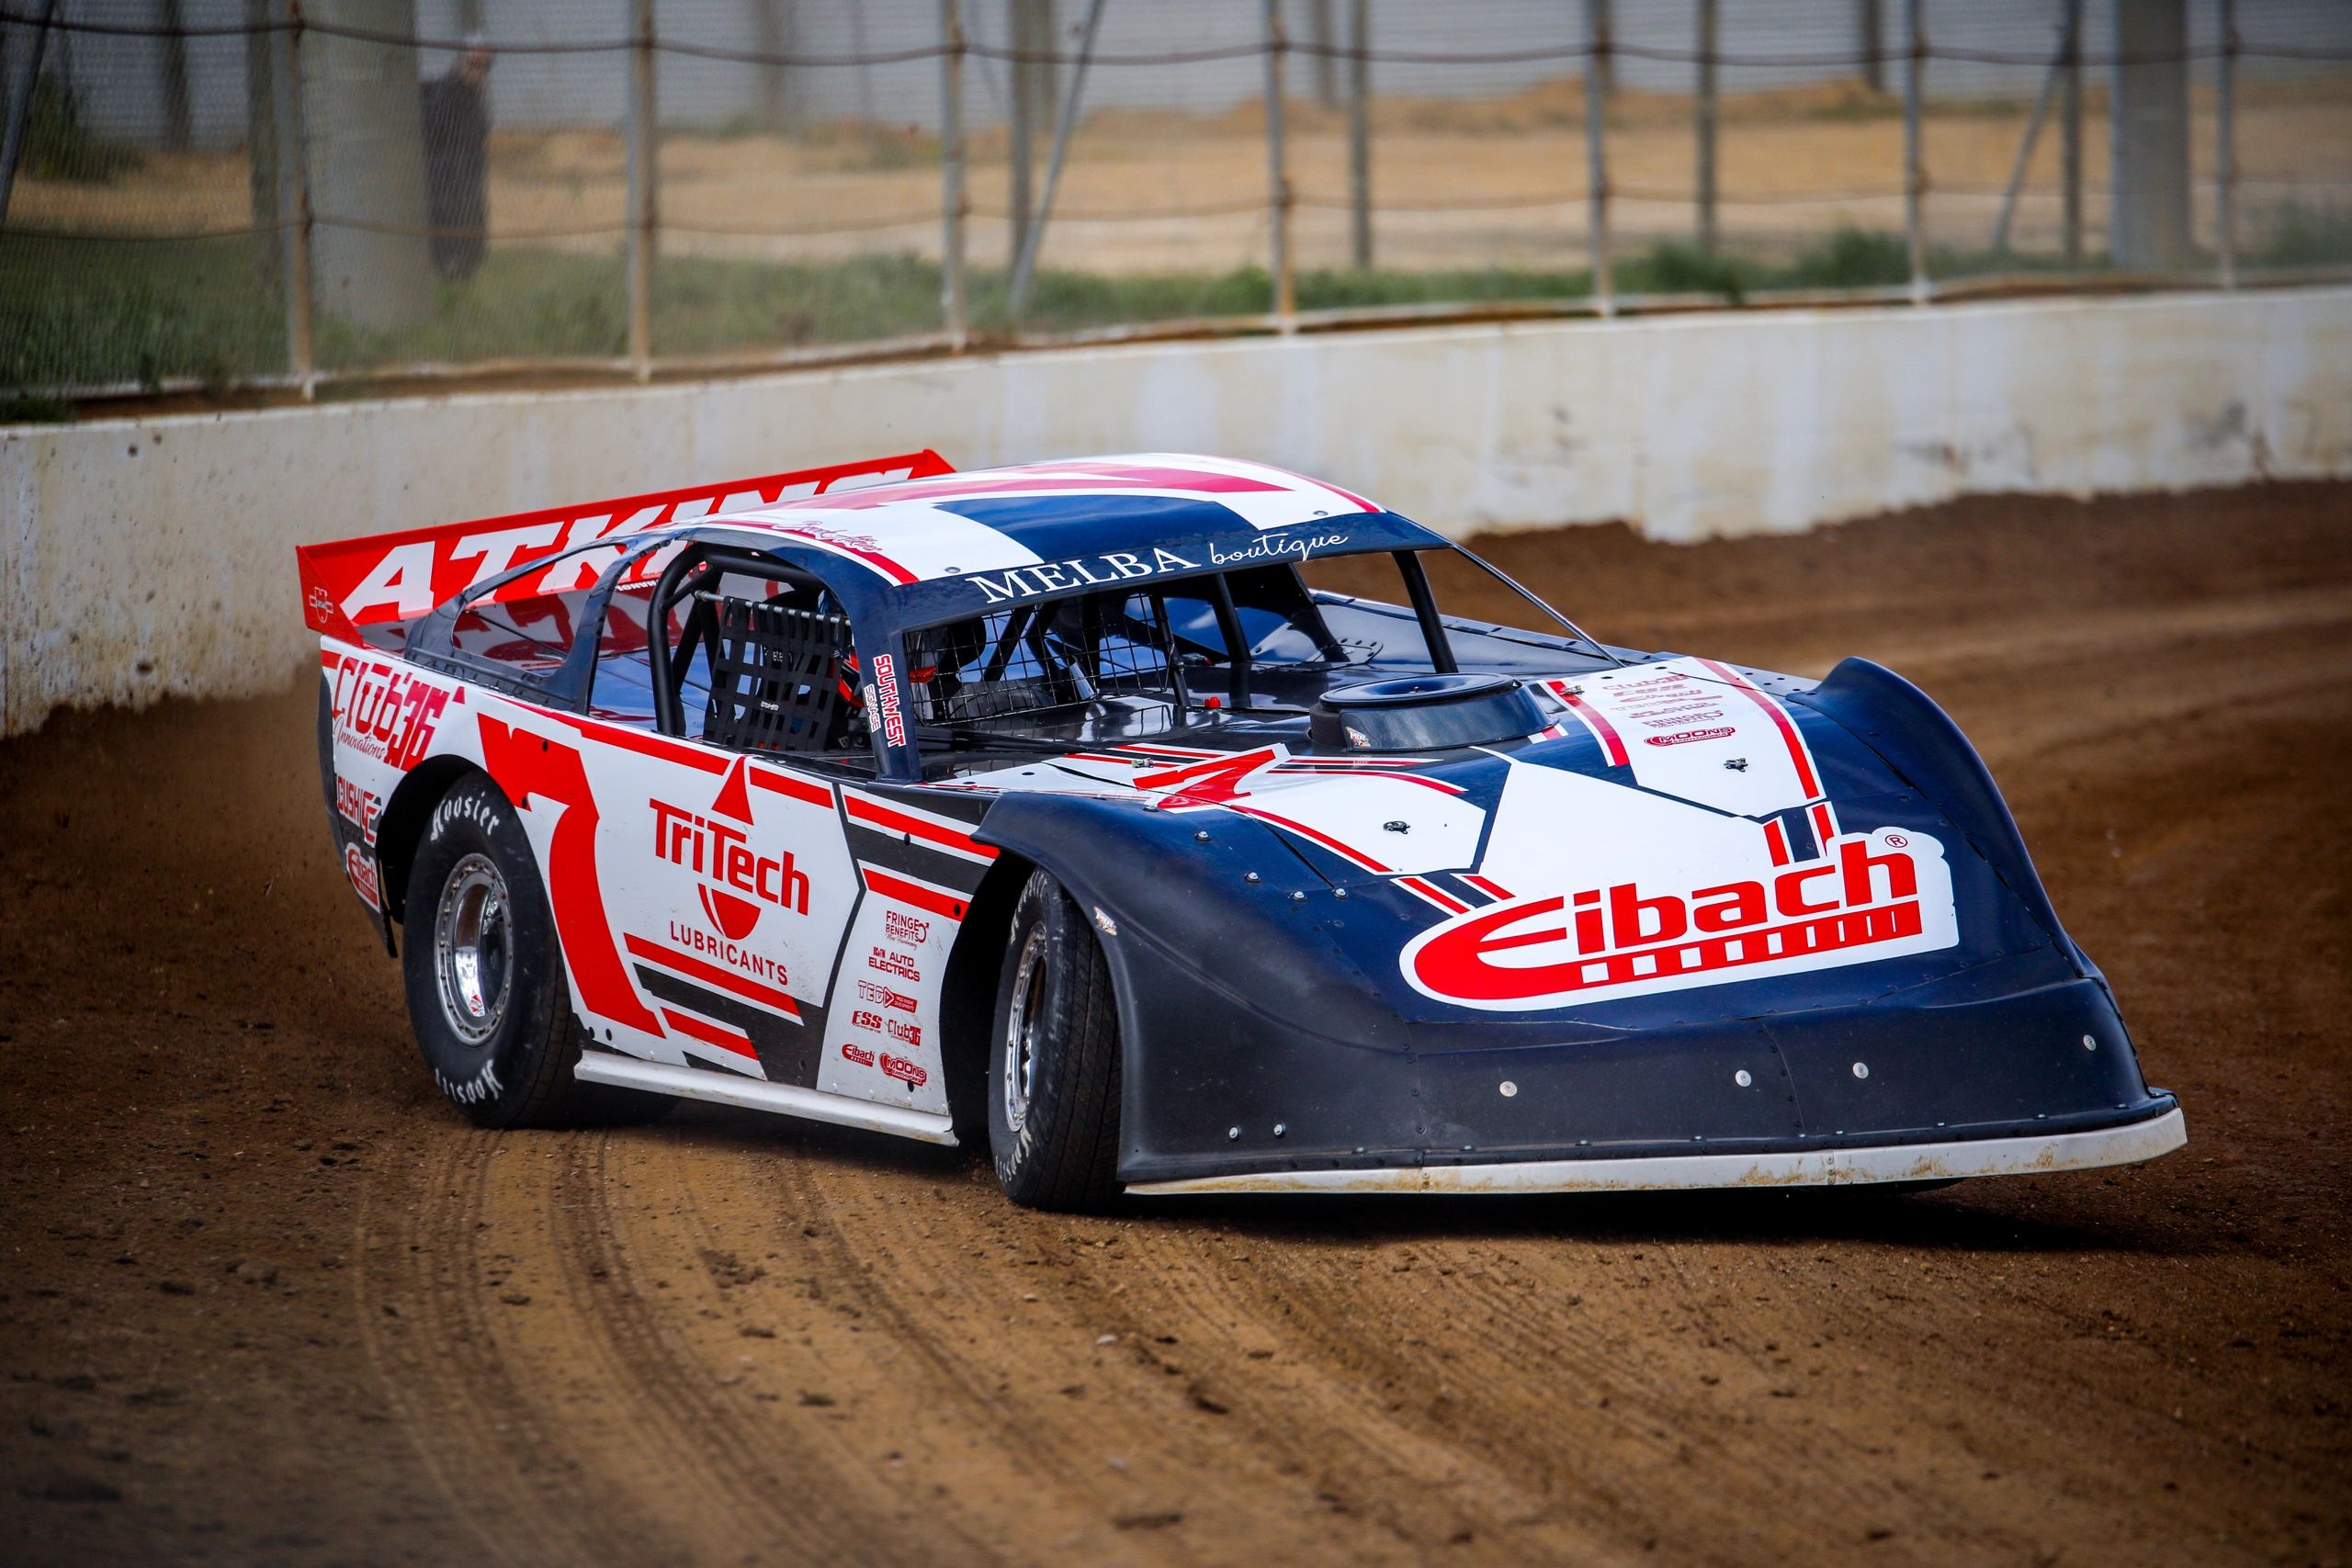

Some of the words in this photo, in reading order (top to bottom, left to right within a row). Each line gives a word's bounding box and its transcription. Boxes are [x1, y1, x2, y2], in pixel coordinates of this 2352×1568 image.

[339, 467, 914, 617] ATKI
[965, 547, 1202, 604] MELBA
[1209, 532, 1350, 562] boutique
[865, 684, 881, 733] SIGNAGE
[874, 654, 906, 749] SOUTHWEST
[431, 791, 499, 840] Hoosier
[650, 797, 809, 917] TriTech
[886, 910, 920, 931] FRINGE
[886, 924, 919, 942] BENEFITS
[1414, 840, 1922, 999] Eibach
[671, 920, 788, 986] LUBRICANTS
[868, 956, 921, 983] ELECTRICS
[889, 952, 914, 968] AUTO
[887, 1057, 925, 1079] MOONS
